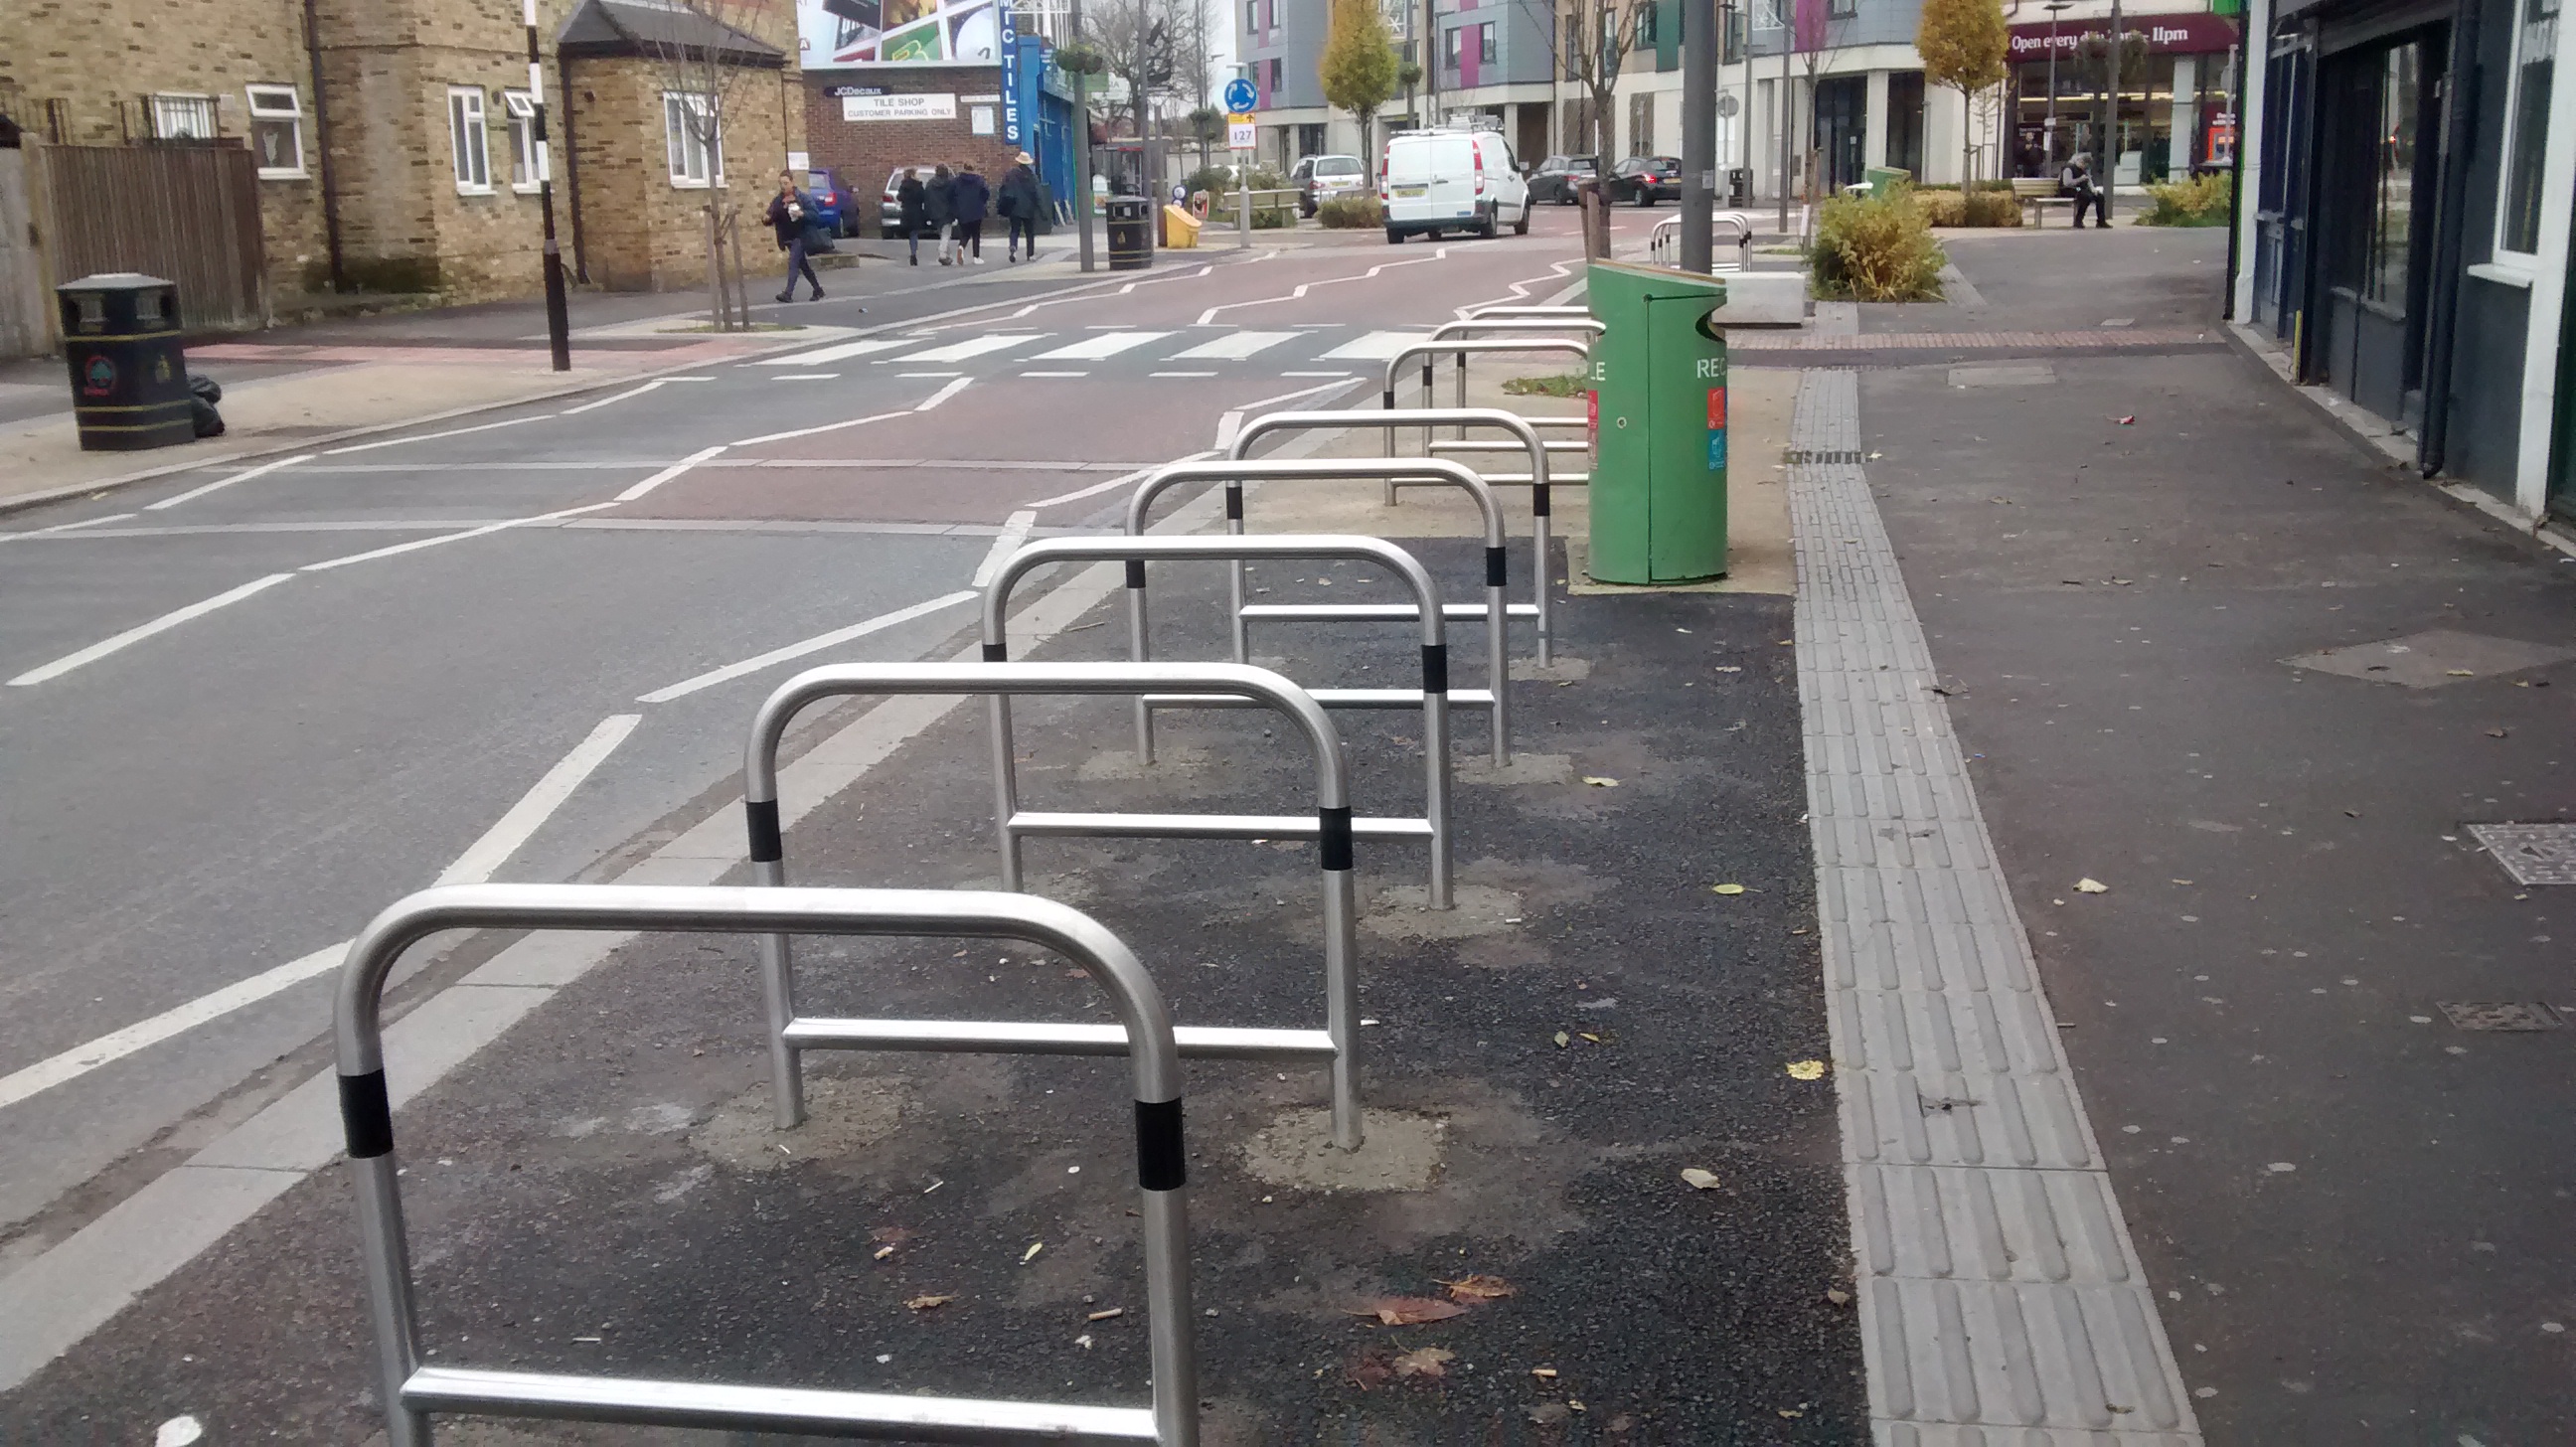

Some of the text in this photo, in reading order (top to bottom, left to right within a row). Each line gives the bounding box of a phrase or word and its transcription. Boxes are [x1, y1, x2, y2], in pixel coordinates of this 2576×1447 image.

[2012, 35, 2041, 53] Open
[2153, 26, 2188, 45] 11pm
[834, 85, 882, 96] JCDecaux
[874, 97, 924, 107] TILE SHOP
[1004, 55, 1019, 140] TILES
[1234, 130, 1251, 140] 127
